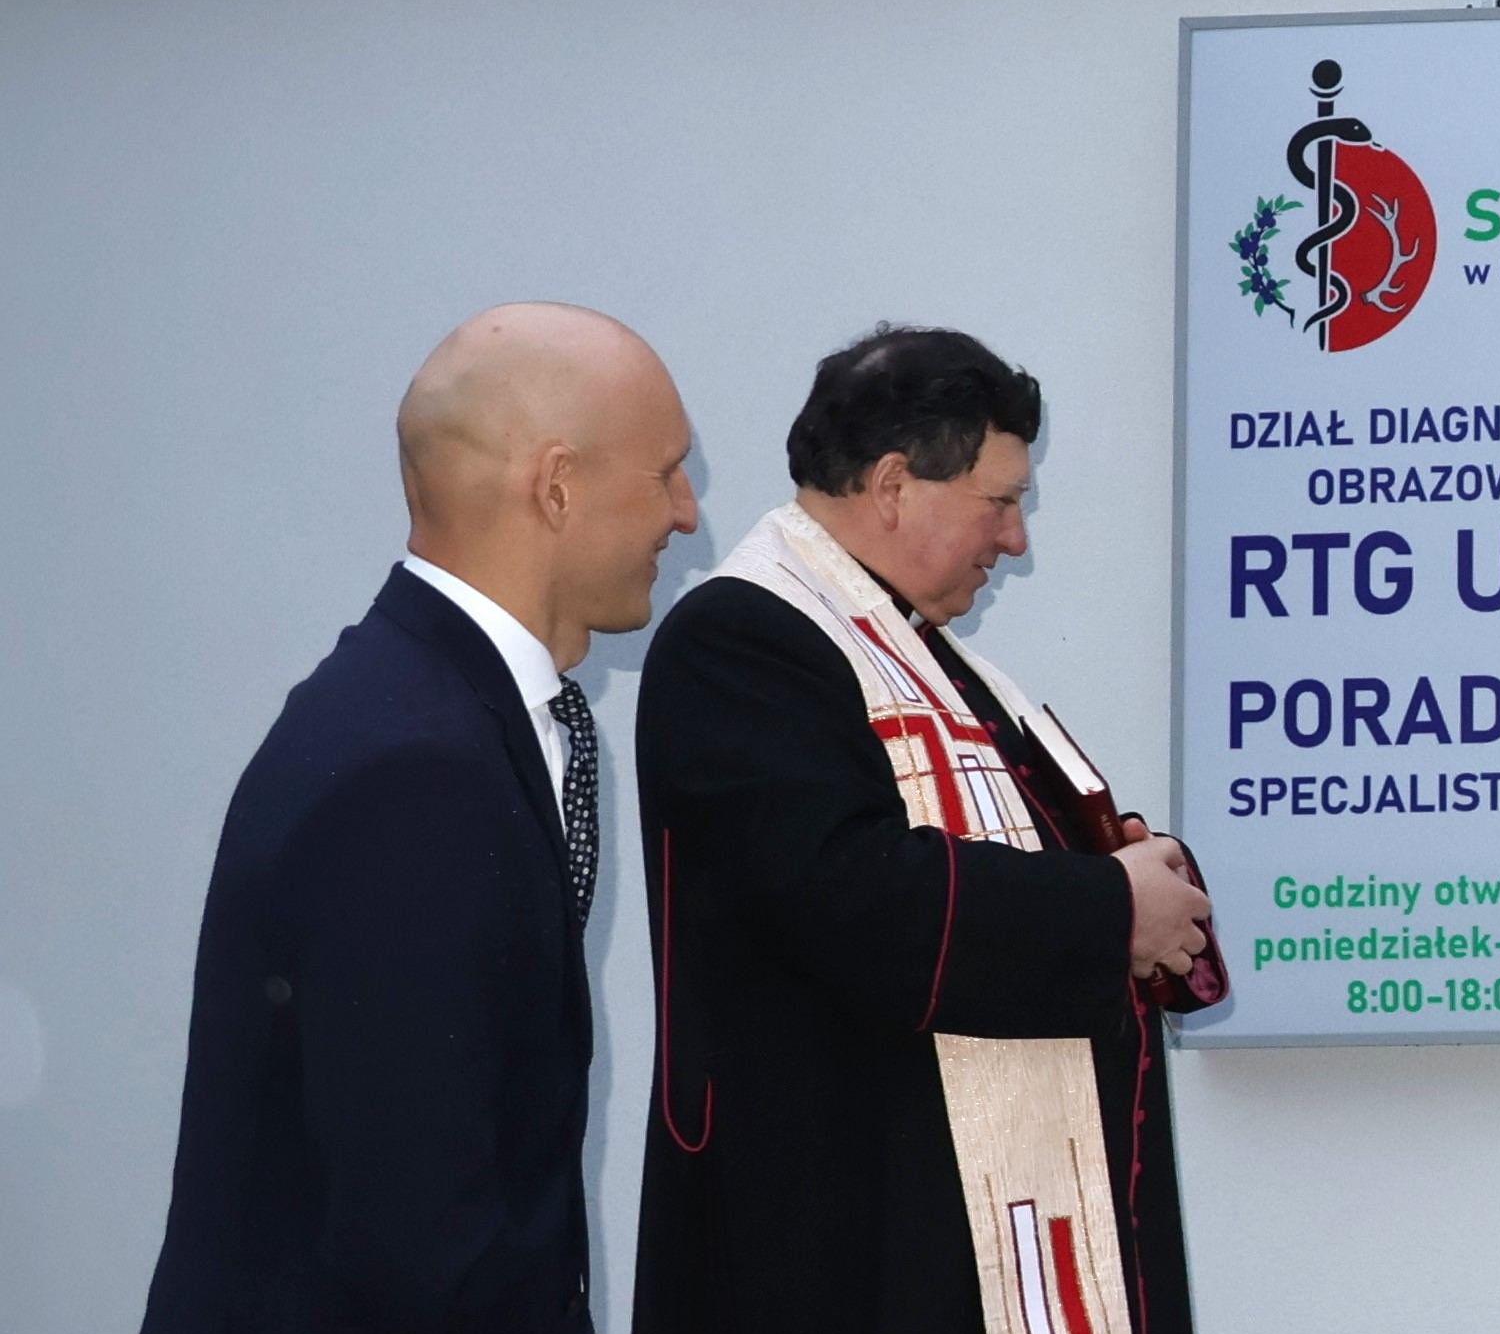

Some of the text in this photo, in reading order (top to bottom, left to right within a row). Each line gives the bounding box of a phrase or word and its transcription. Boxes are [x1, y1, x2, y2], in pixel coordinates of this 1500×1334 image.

[1463, 264, 1491, 285] w
[1230, 410, 1354, 450] DZIAŁ
[1230, 530, 1414, 619] RTG
[1273, 875, 1422, 916] Godziny
